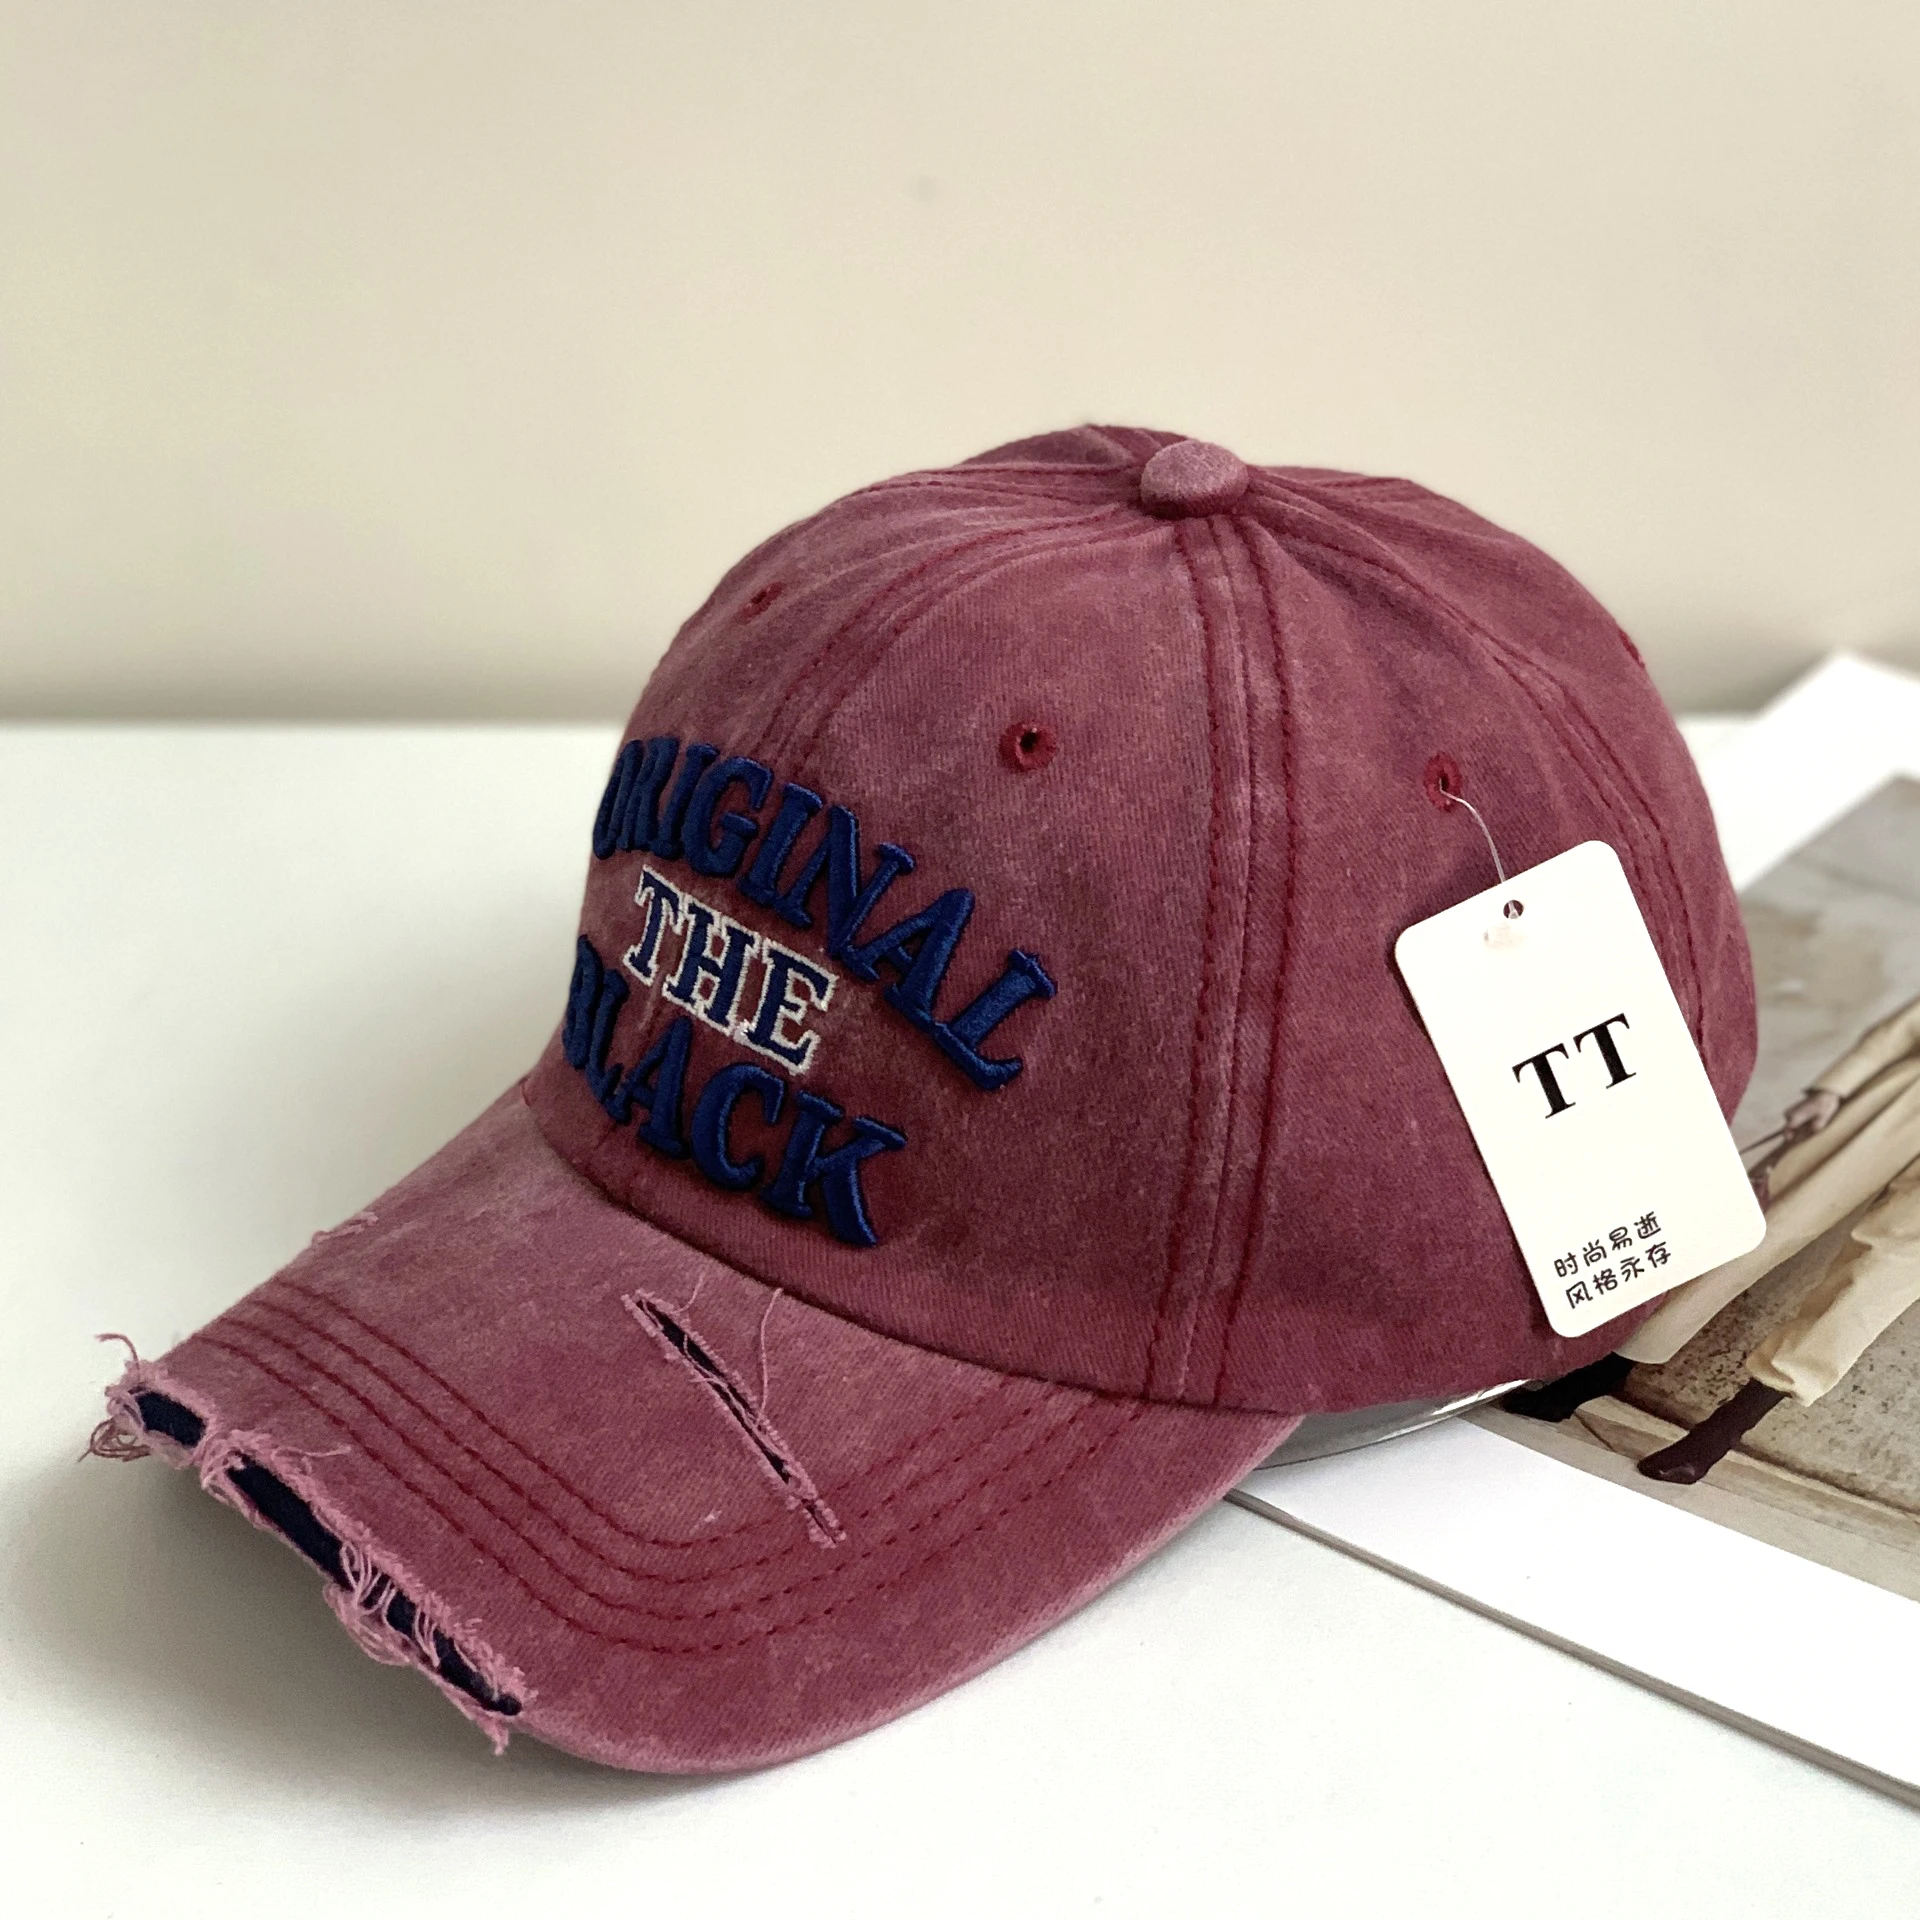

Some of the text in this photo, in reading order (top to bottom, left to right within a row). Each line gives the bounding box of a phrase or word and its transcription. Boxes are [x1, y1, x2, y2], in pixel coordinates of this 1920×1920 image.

[593, 737, 1056, 1089] ORIGINAL
[623, 864, 838, 1076] THE
[562, 935, 907, 1247] BLACK
[1511, 1012, 1636, 1119] TT
[1554, 1211, 1662, 1278] 时尚易逝
[1565, 1241, 1672, 1309] 风格永存
